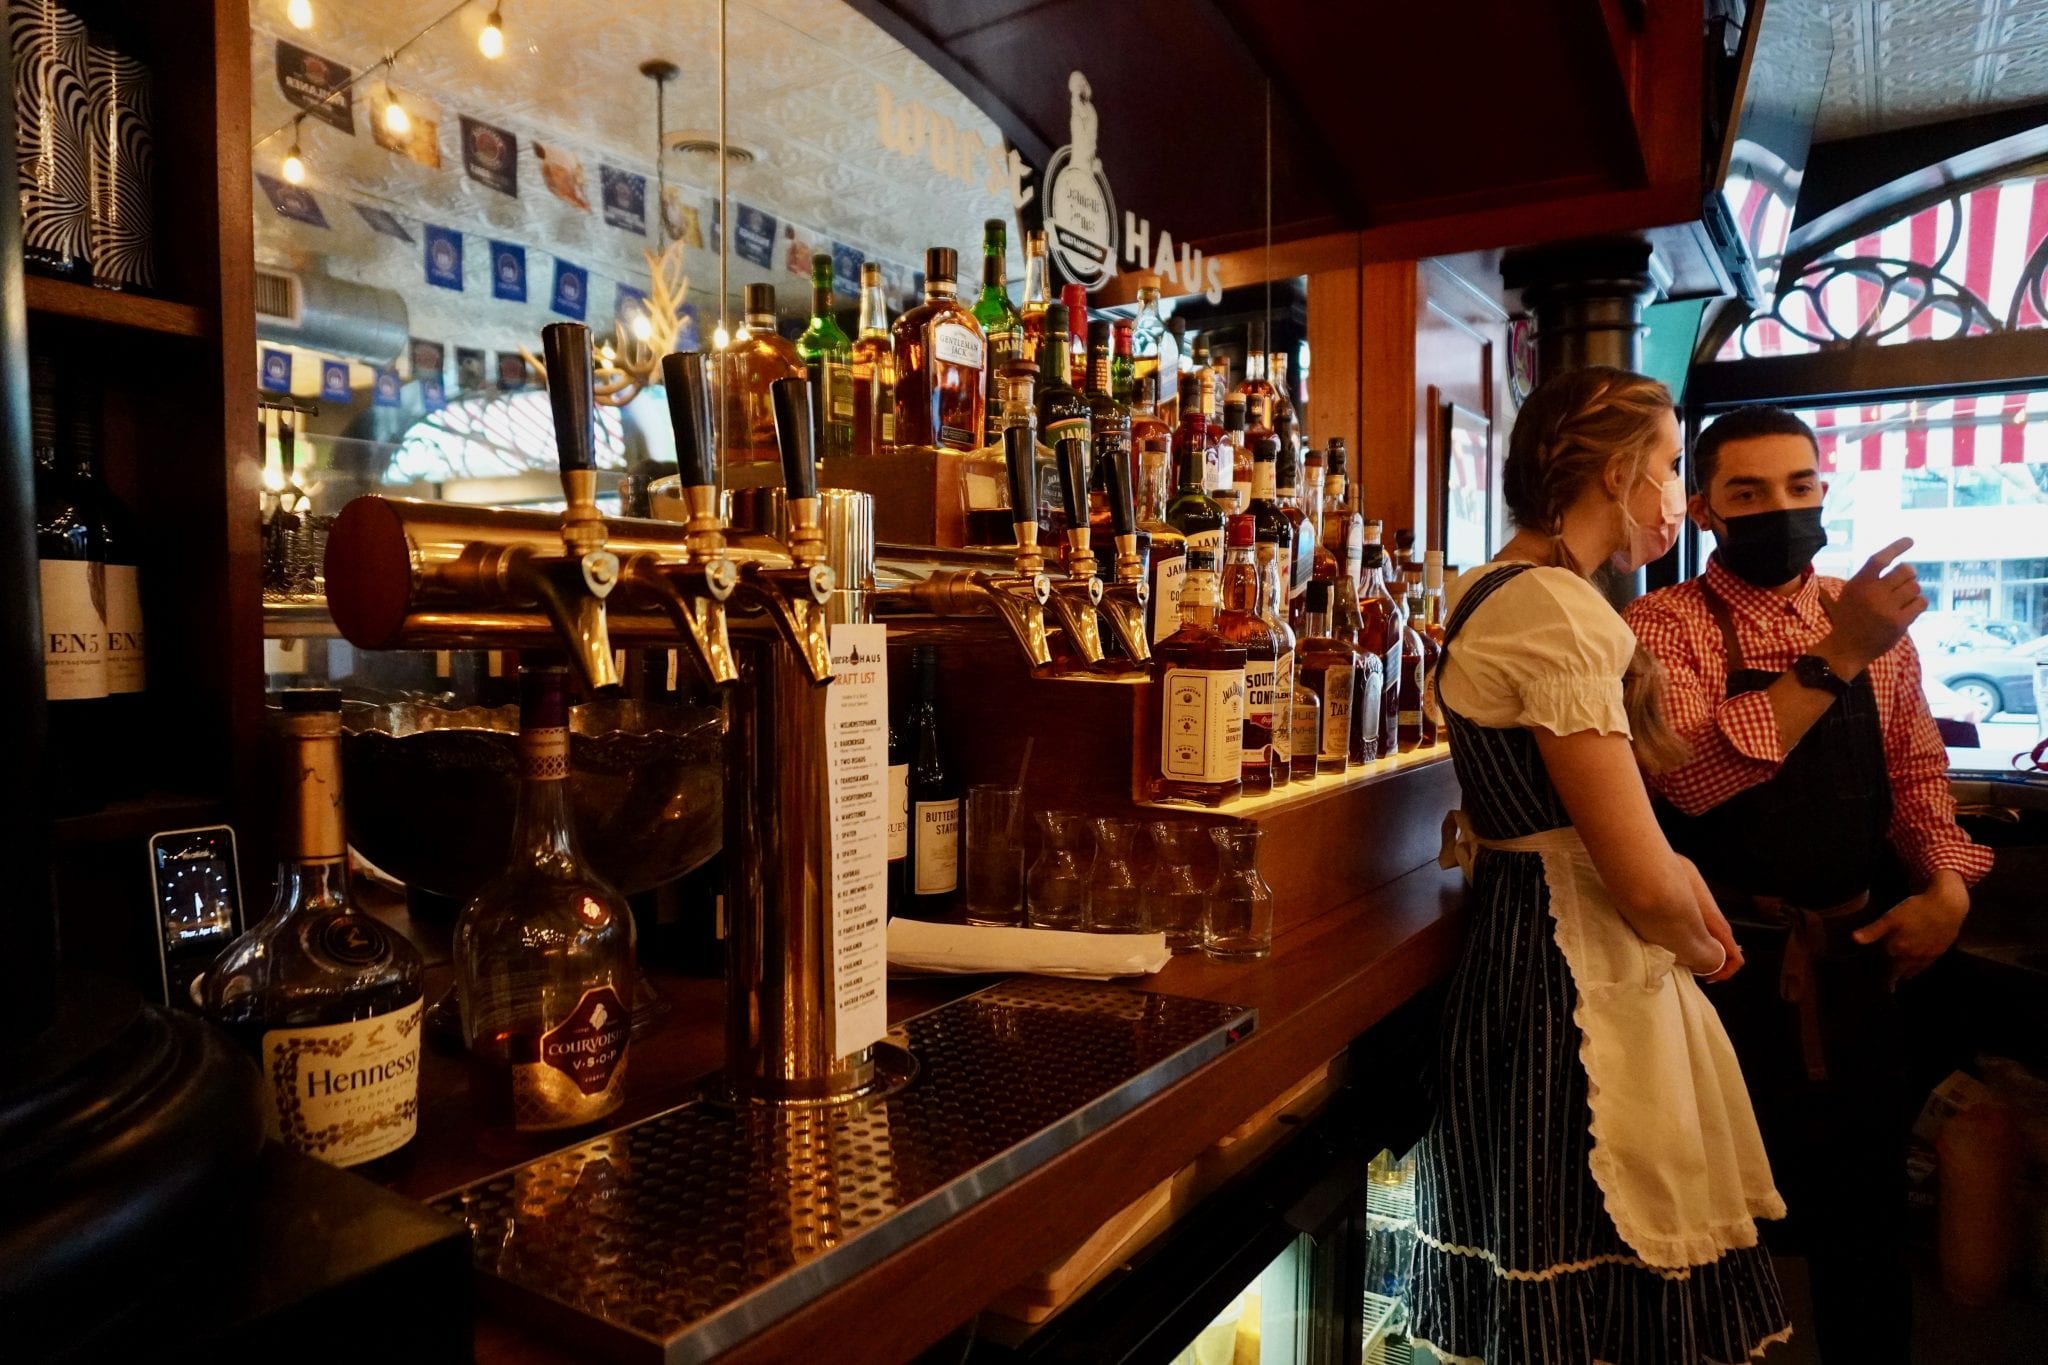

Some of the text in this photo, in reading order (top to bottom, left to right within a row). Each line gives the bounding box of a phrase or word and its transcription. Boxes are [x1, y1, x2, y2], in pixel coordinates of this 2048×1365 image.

[873, 82, 1223, 306] wurst HAUS
[939, 334, 979, 352] GENTLEMAN
[951, 345, 967, 357] JACK
[1166, 563, 1186, 578] JAM
[859, 654, 881, 663] HAUS
[860, 671, 876, 684] LIST
[307, 1050, 417, 1099] Hennessy
